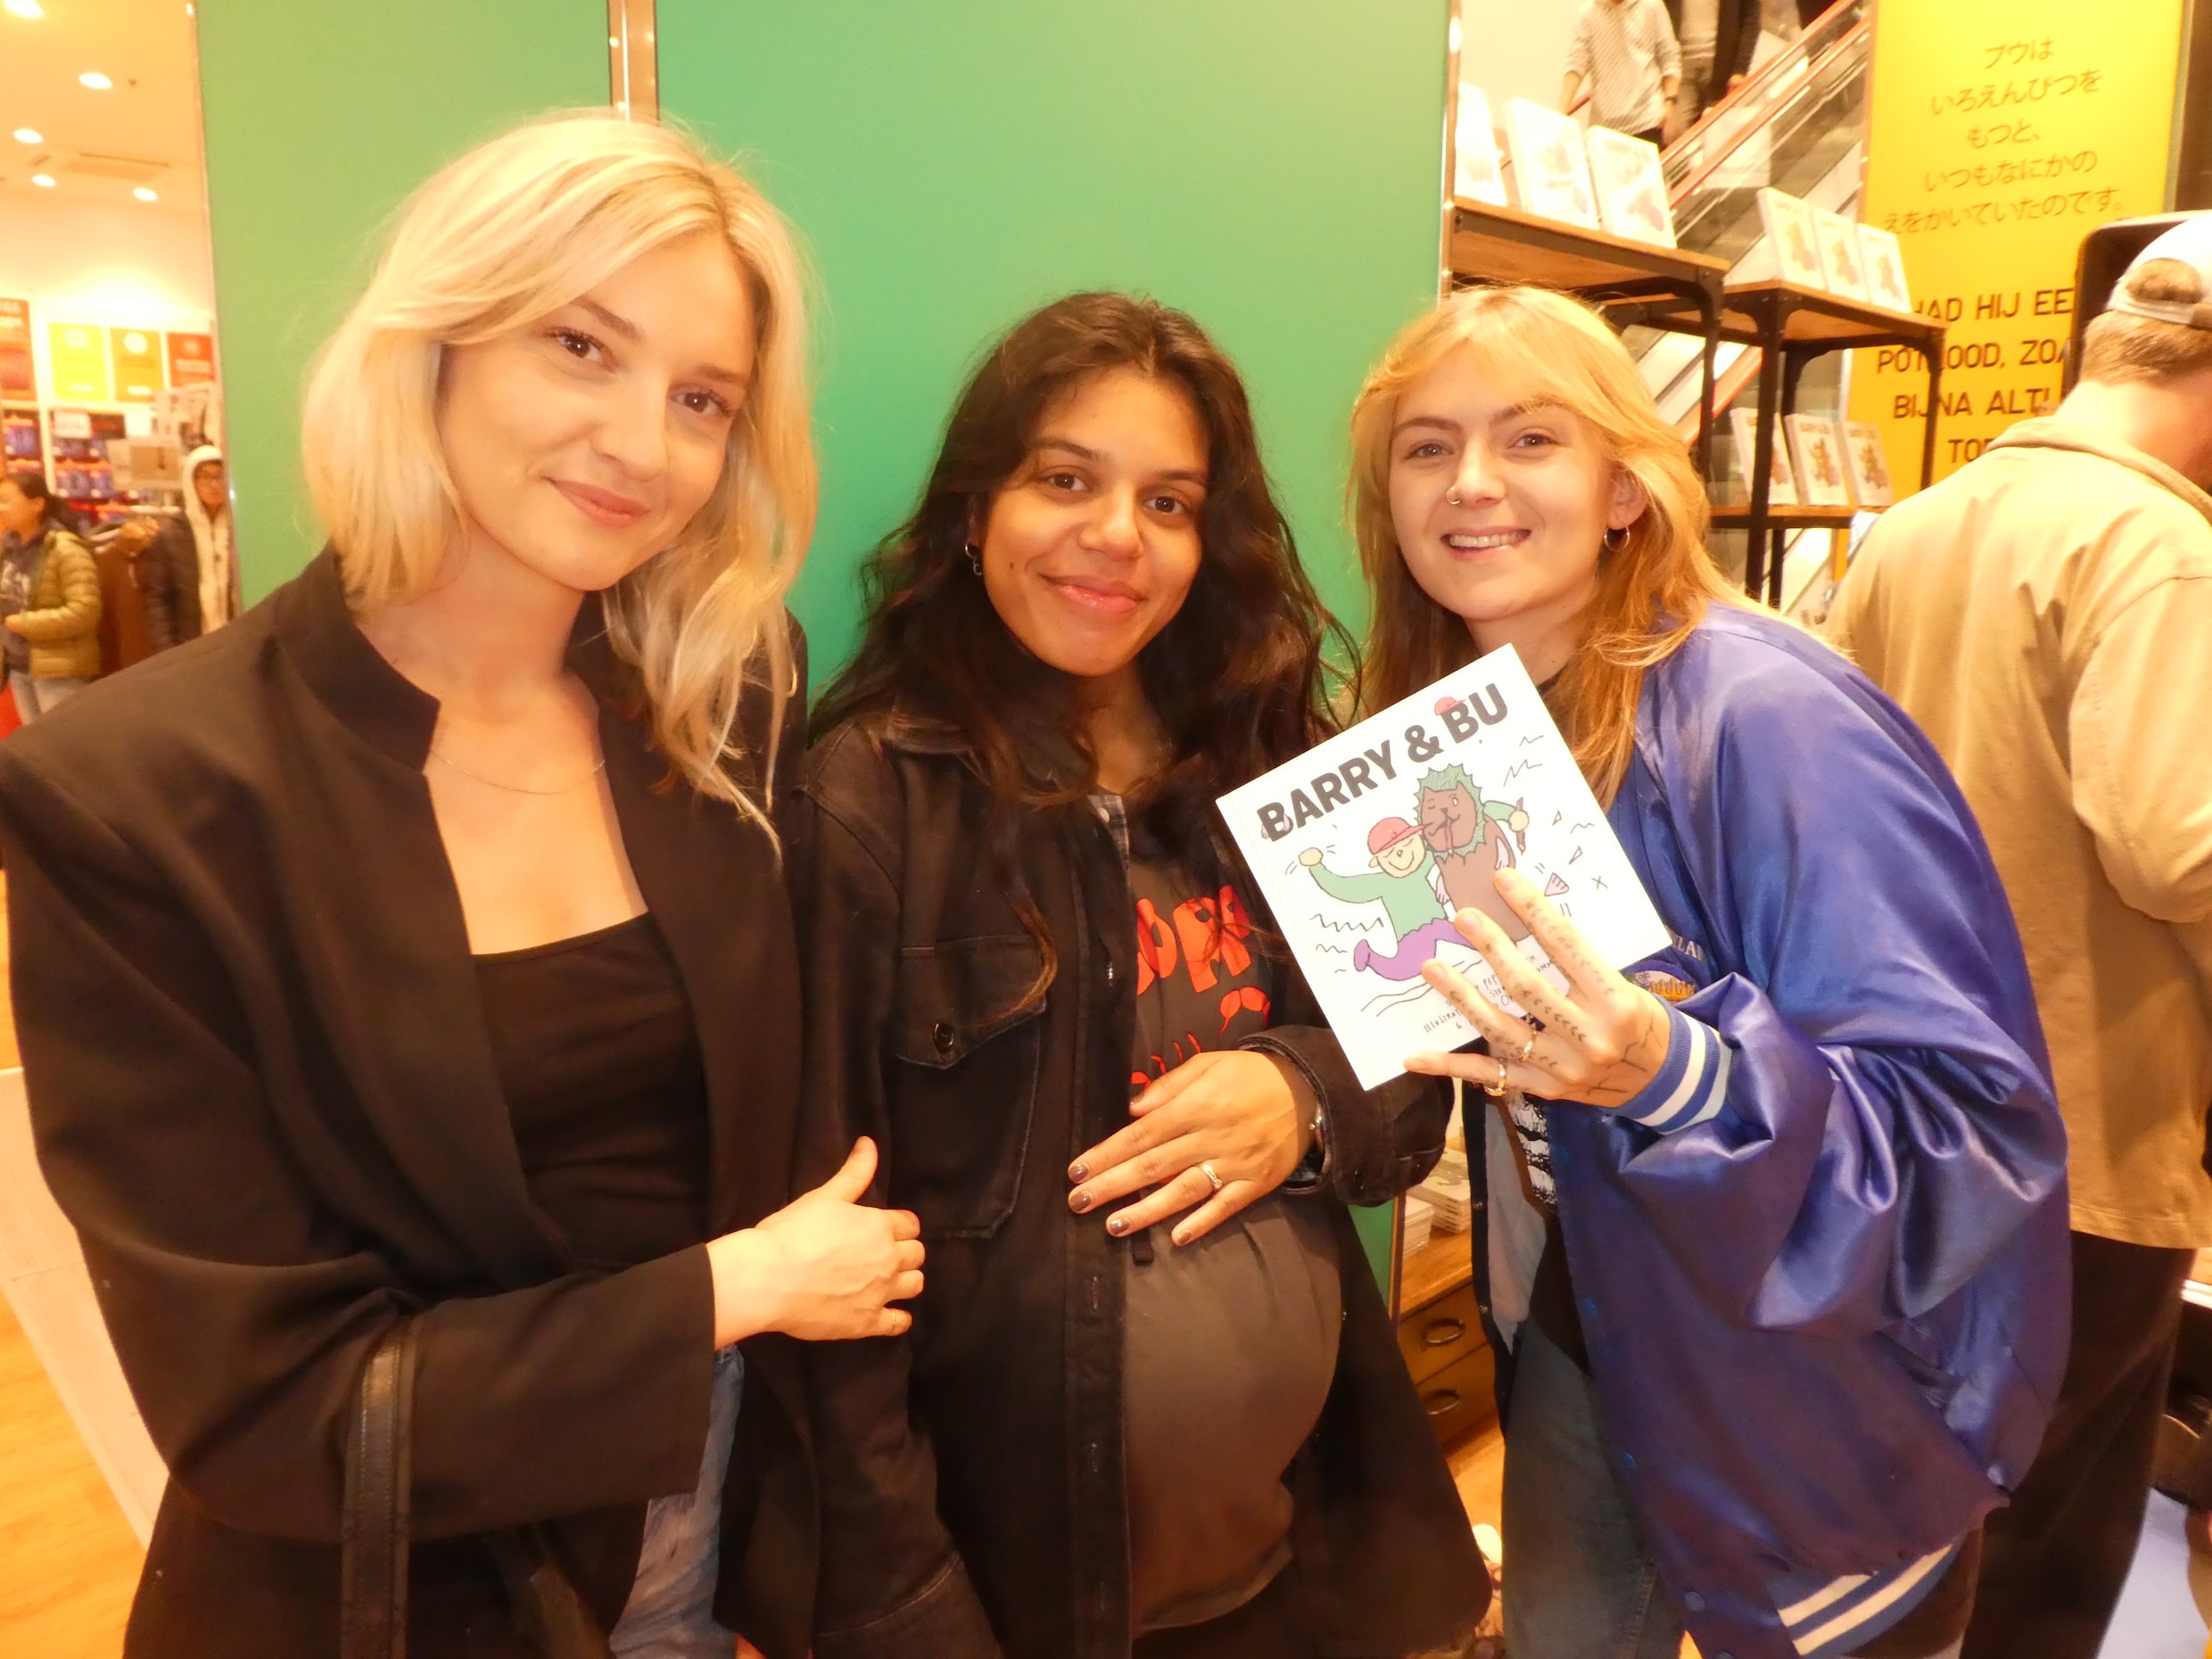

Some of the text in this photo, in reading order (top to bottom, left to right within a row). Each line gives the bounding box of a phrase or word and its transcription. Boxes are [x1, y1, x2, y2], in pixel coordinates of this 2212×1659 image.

[1925, 150, 2099, 193] いつもなにかの
[1974, 292, 2021, 320] HIJ
[2034, 287, 2074, 317] EE
[1947, 437, 1996, 464] TO
[1256, 682, 1508, 843] BARRY & BU
